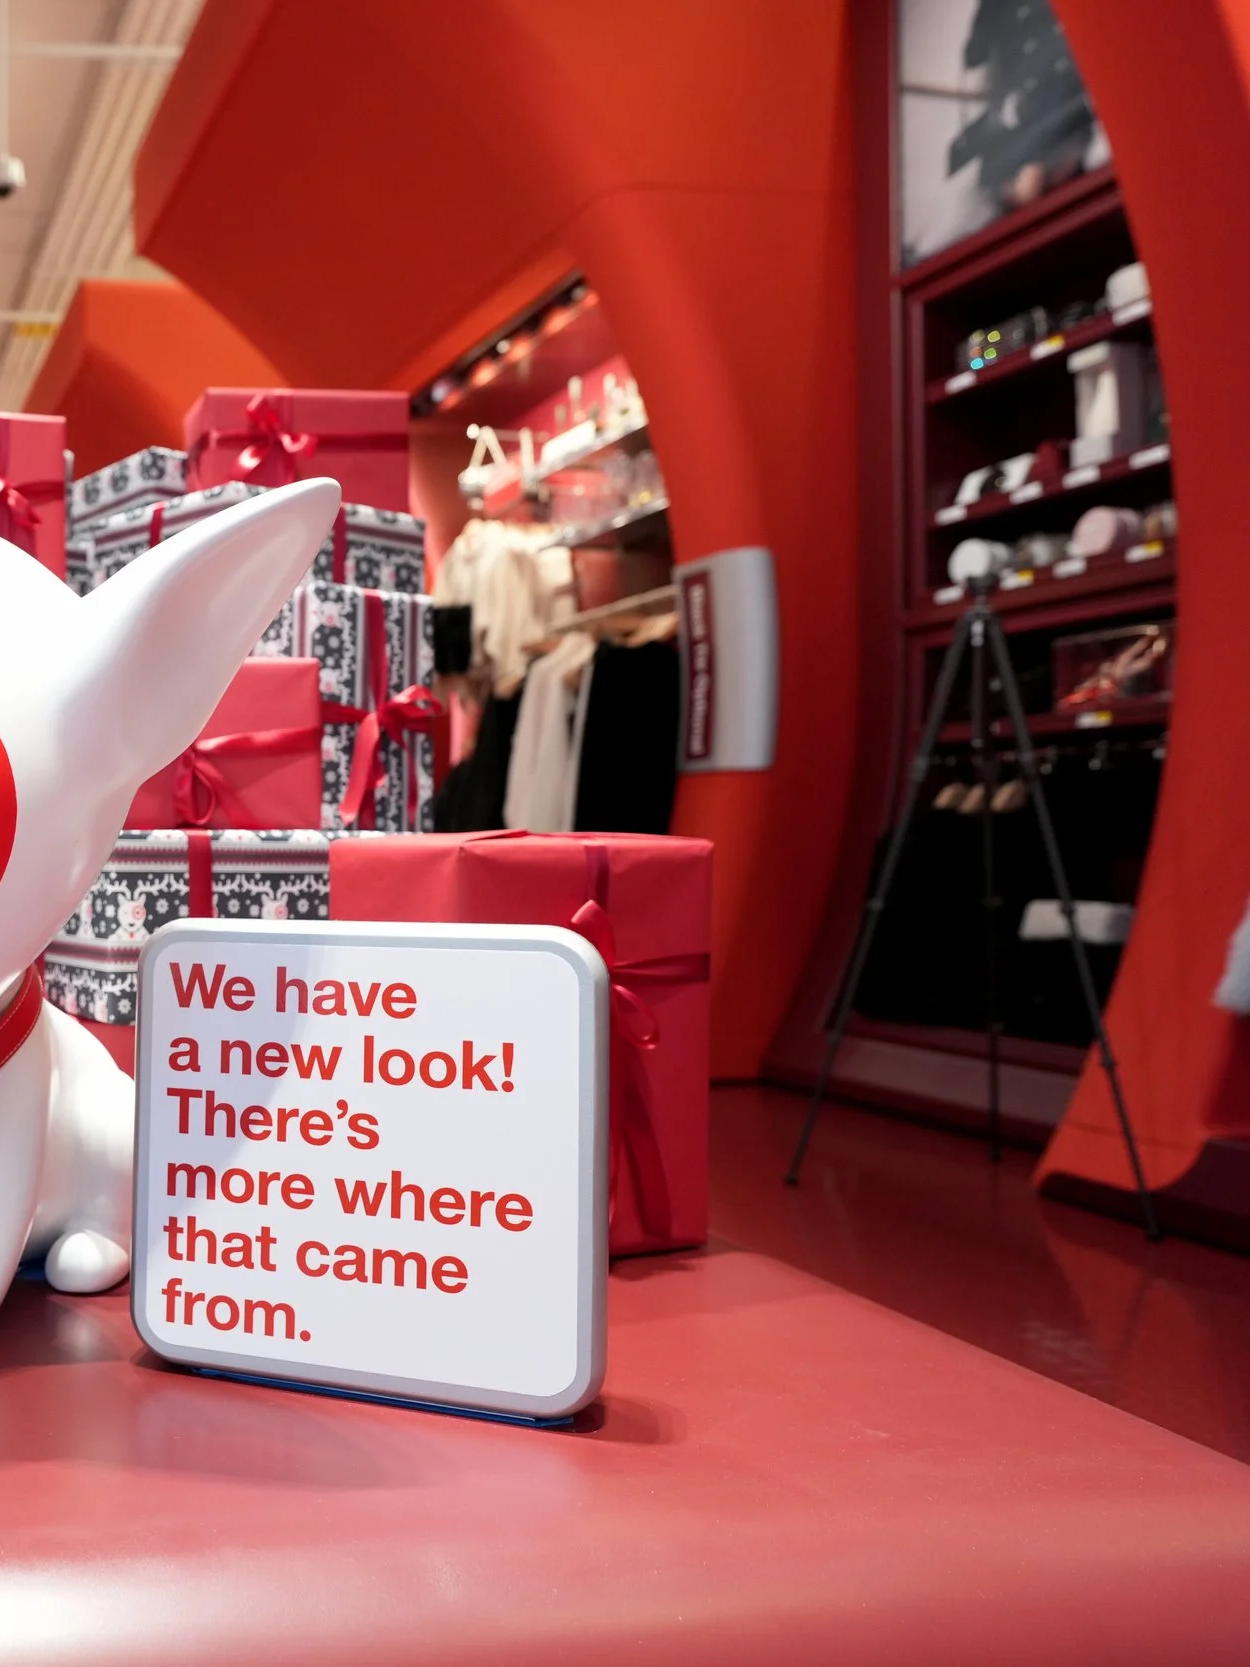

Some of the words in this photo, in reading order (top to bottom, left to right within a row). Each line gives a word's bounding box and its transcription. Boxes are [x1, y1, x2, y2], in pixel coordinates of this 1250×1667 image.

[169, 961, 256, 1012] We
[275, 965, 418, 1020] have
[167, 1036, 202, 1073] a
[219, 1039, 343, 1082] new
[362, 1034, 515, 1094] look!
[166, 1087, 381, 1151] There’s
[166, 1162, 316, 1211] more
[333, 1169, 534, 1233] where
[162, 1215, 278, 1273] that
[295, 1239, 469, 1295] came
[161, 1276, 312, 1343] from.
